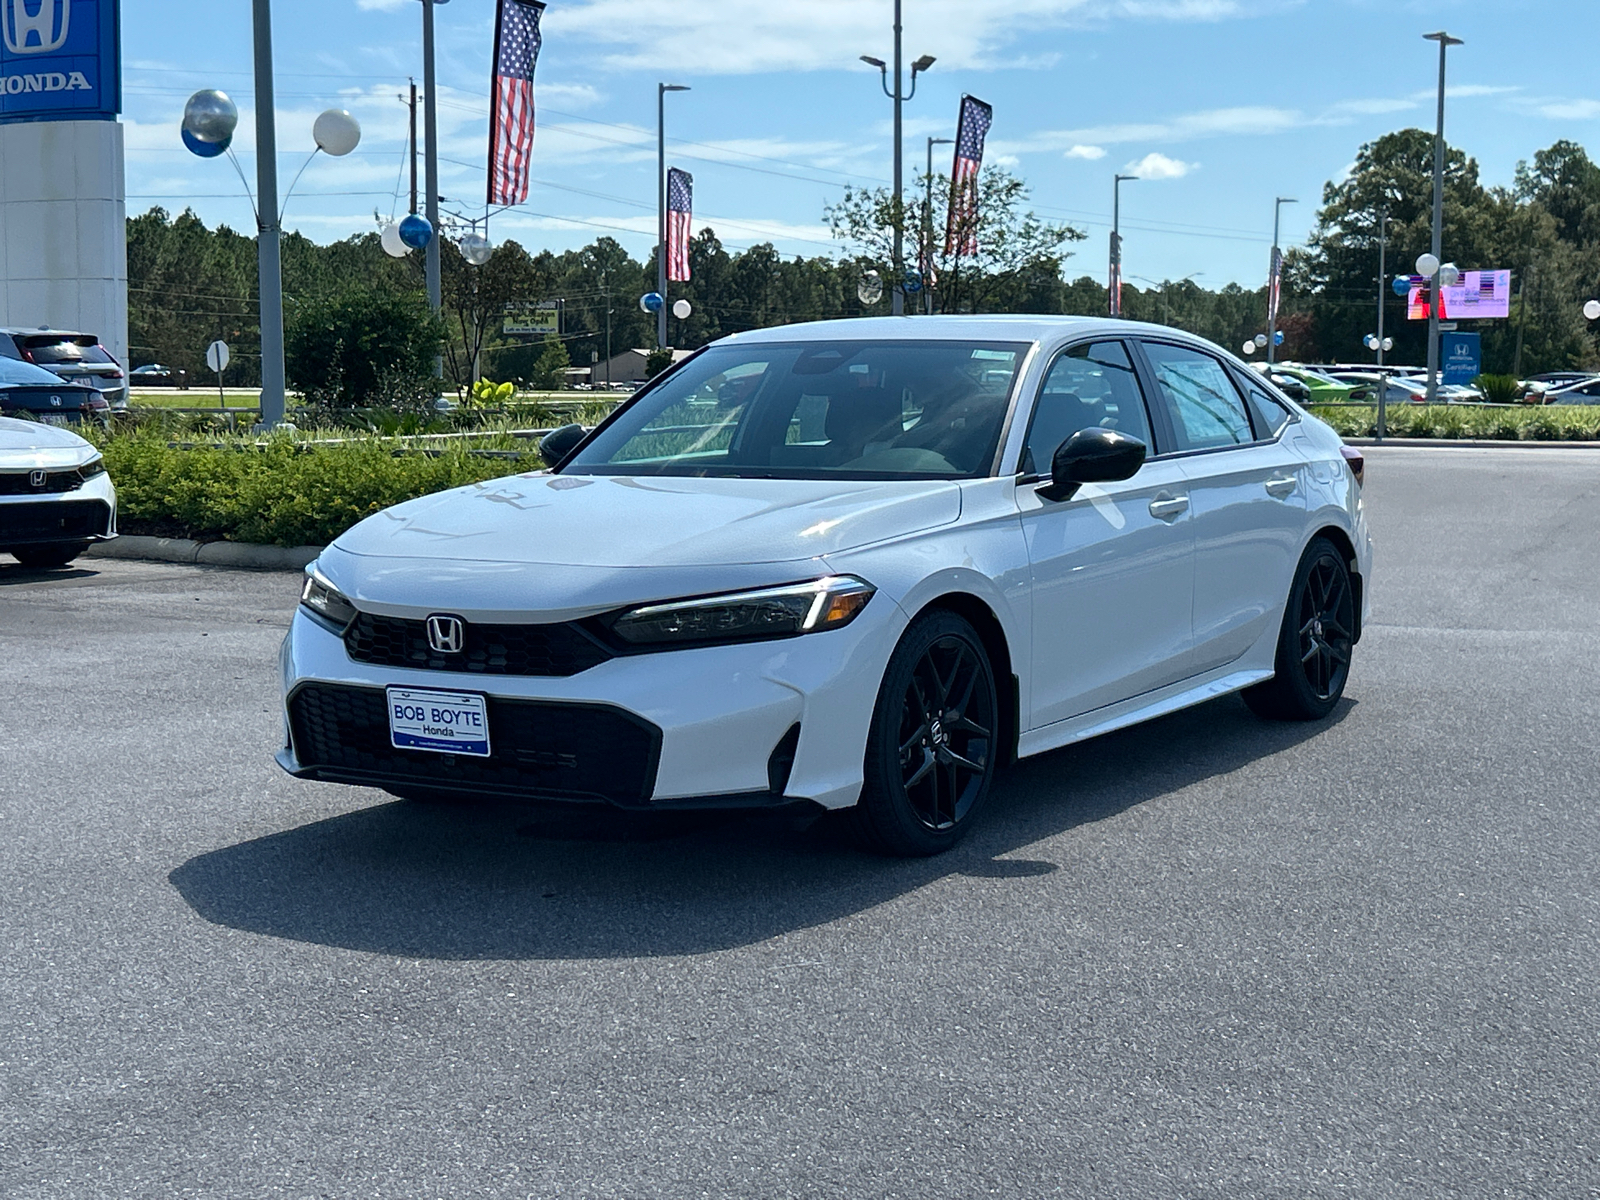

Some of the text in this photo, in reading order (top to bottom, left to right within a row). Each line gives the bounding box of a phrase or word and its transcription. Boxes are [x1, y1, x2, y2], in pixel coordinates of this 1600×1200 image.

[1445, 363, 1478, 371] Certified
[394, 705, 482, 727] BOB BOYTE
[422, 724, 455, 737] Honda
